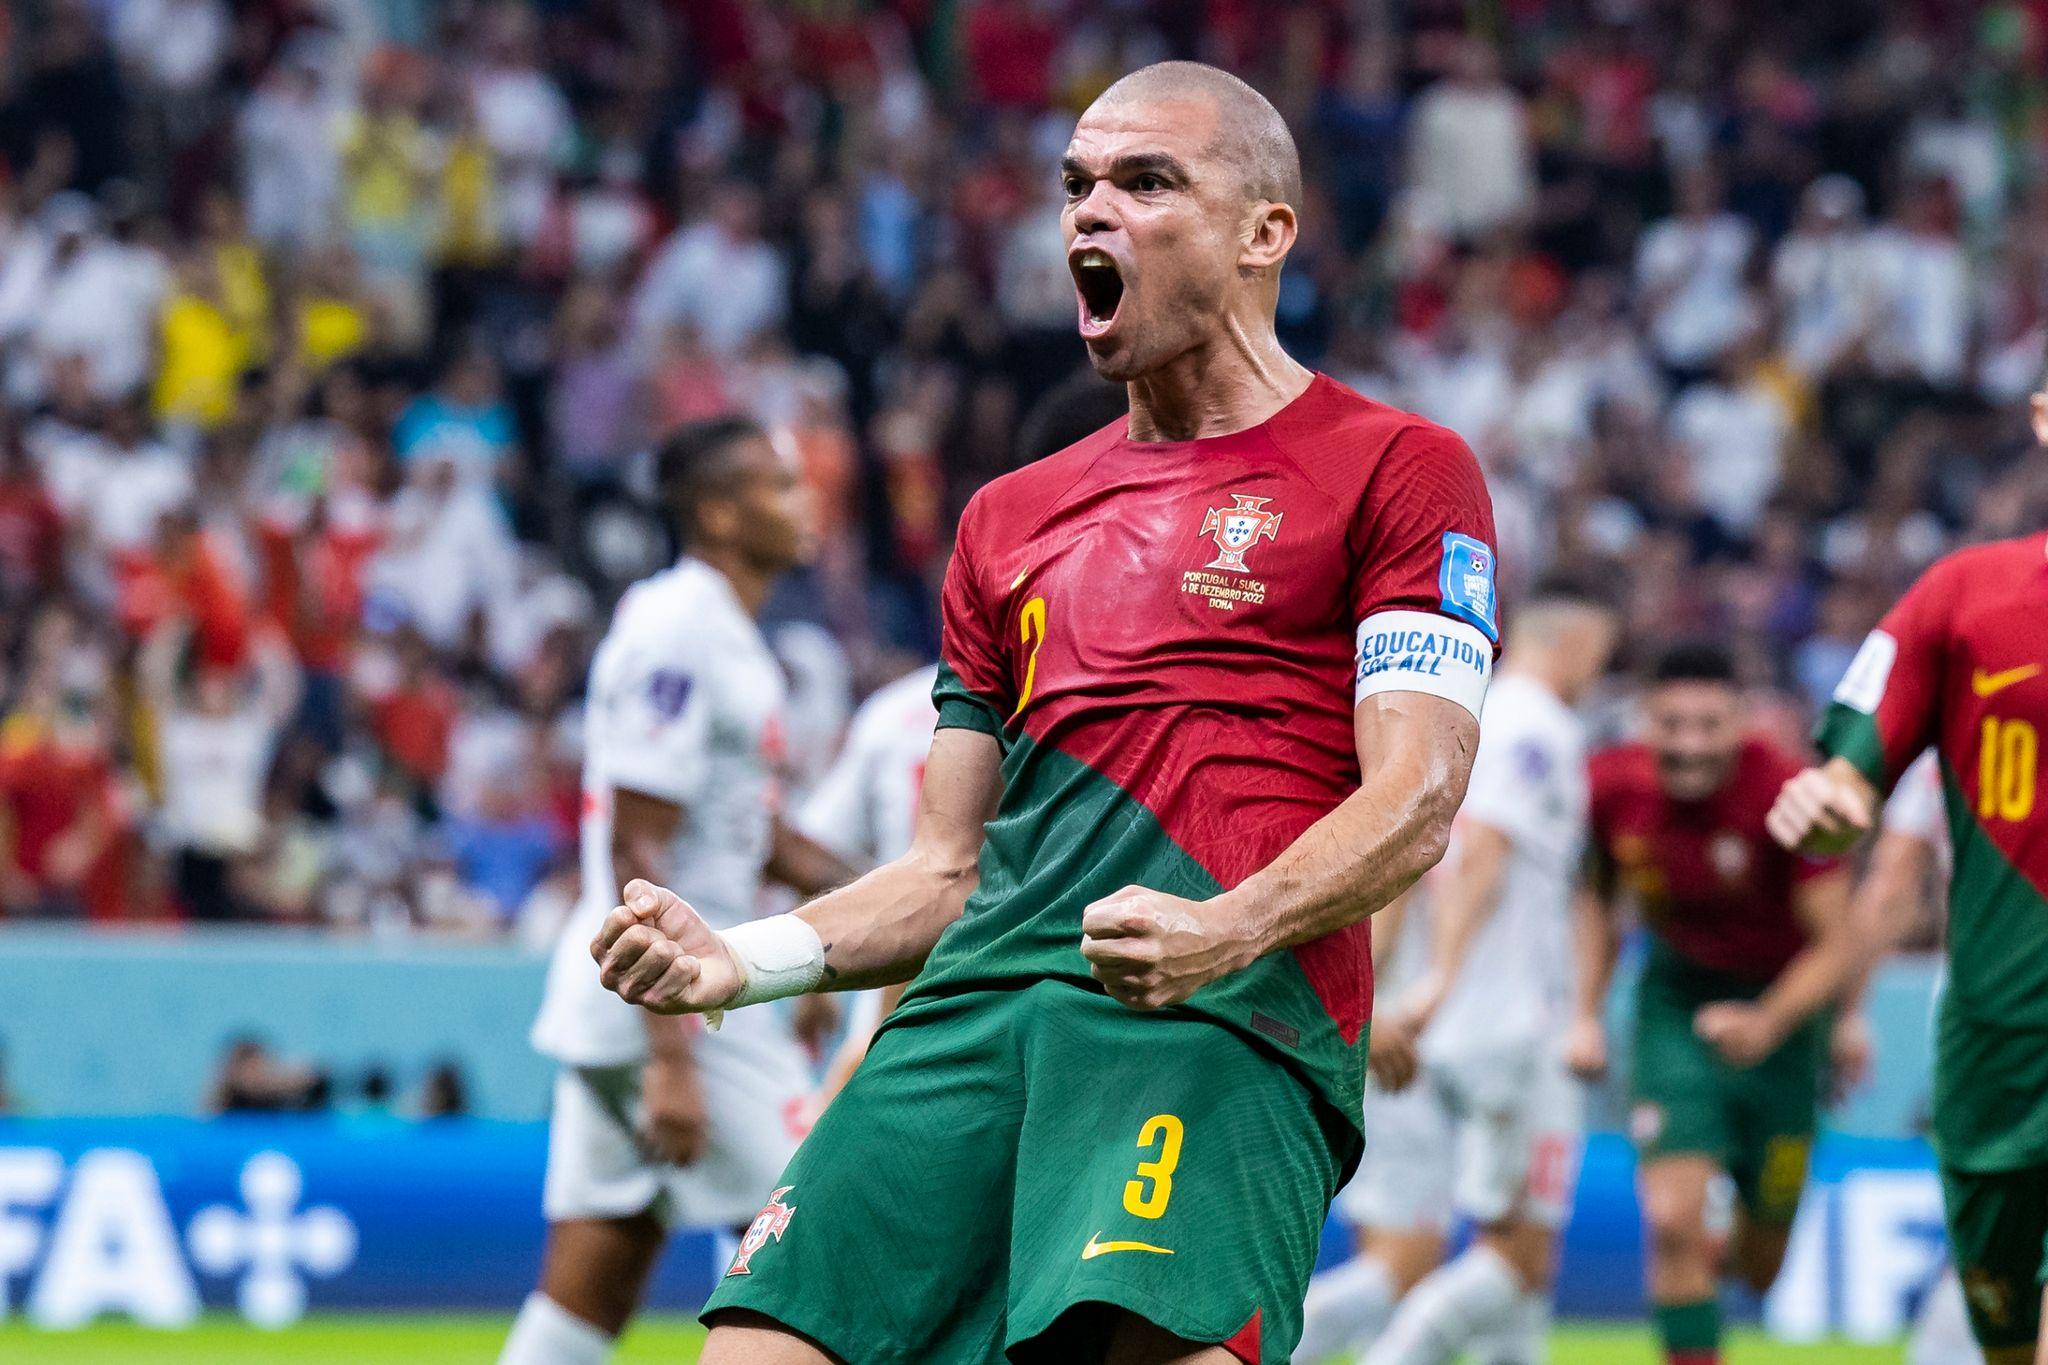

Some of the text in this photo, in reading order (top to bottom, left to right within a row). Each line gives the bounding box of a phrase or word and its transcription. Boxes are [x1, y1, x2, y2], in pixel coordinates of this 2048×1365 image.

[1183, 571, 1229, 587] PORTUGAL
[1181, 582, 1265, 604] 6 DE DEZEMBRO 2022
[1209, 598, 1233, 611] DOHA
[1362, 631, 1485, 675] EDUCATION
[1398, 654, 1442, 677] ALL
[1978, 715, 2039, 821] 10
[1122, 1114, 1184, 1220] 3
